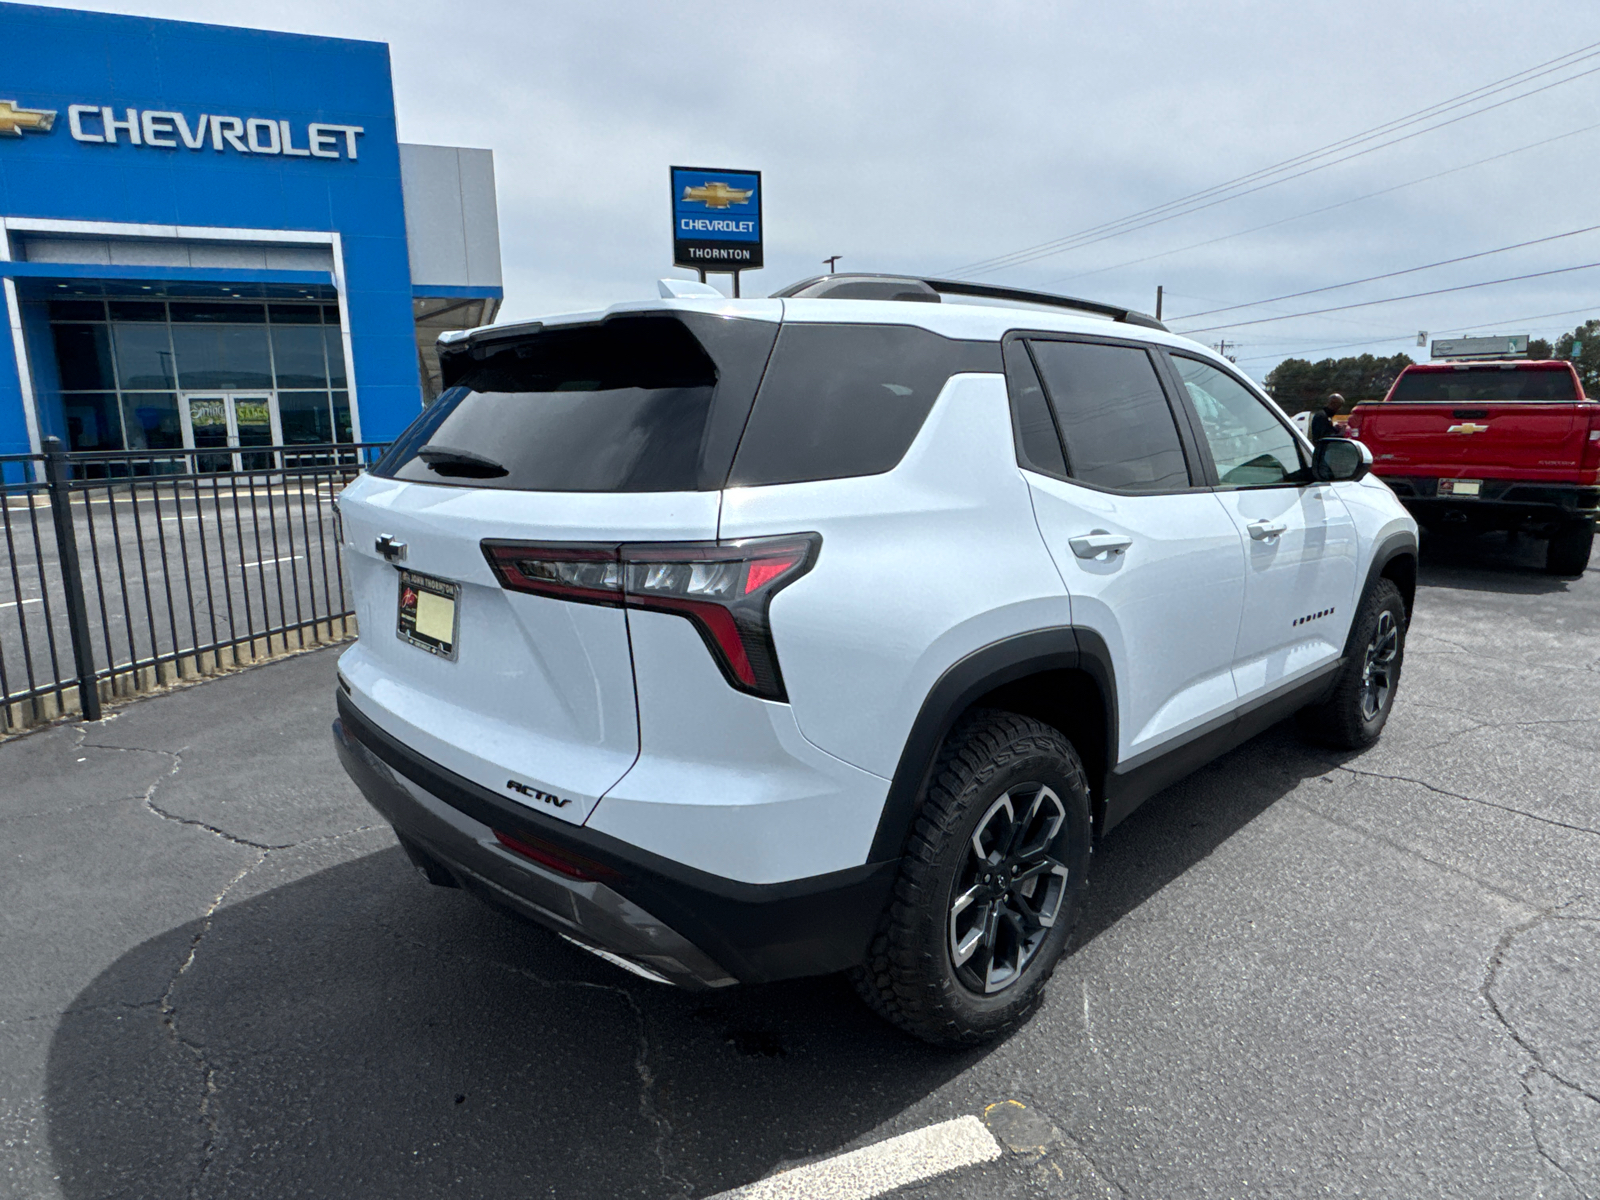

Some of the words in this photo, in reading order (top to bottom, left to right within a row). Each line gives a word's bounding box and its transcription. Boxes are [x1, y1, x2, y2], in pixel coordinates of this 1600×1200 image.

[68, 104, 364, 159] CHEVROLET
[681, 219, 754, 232] CHEVROLET
[688, 248, 750, 259] THORNTON
[506, 779, 573, 808] ACTIV
